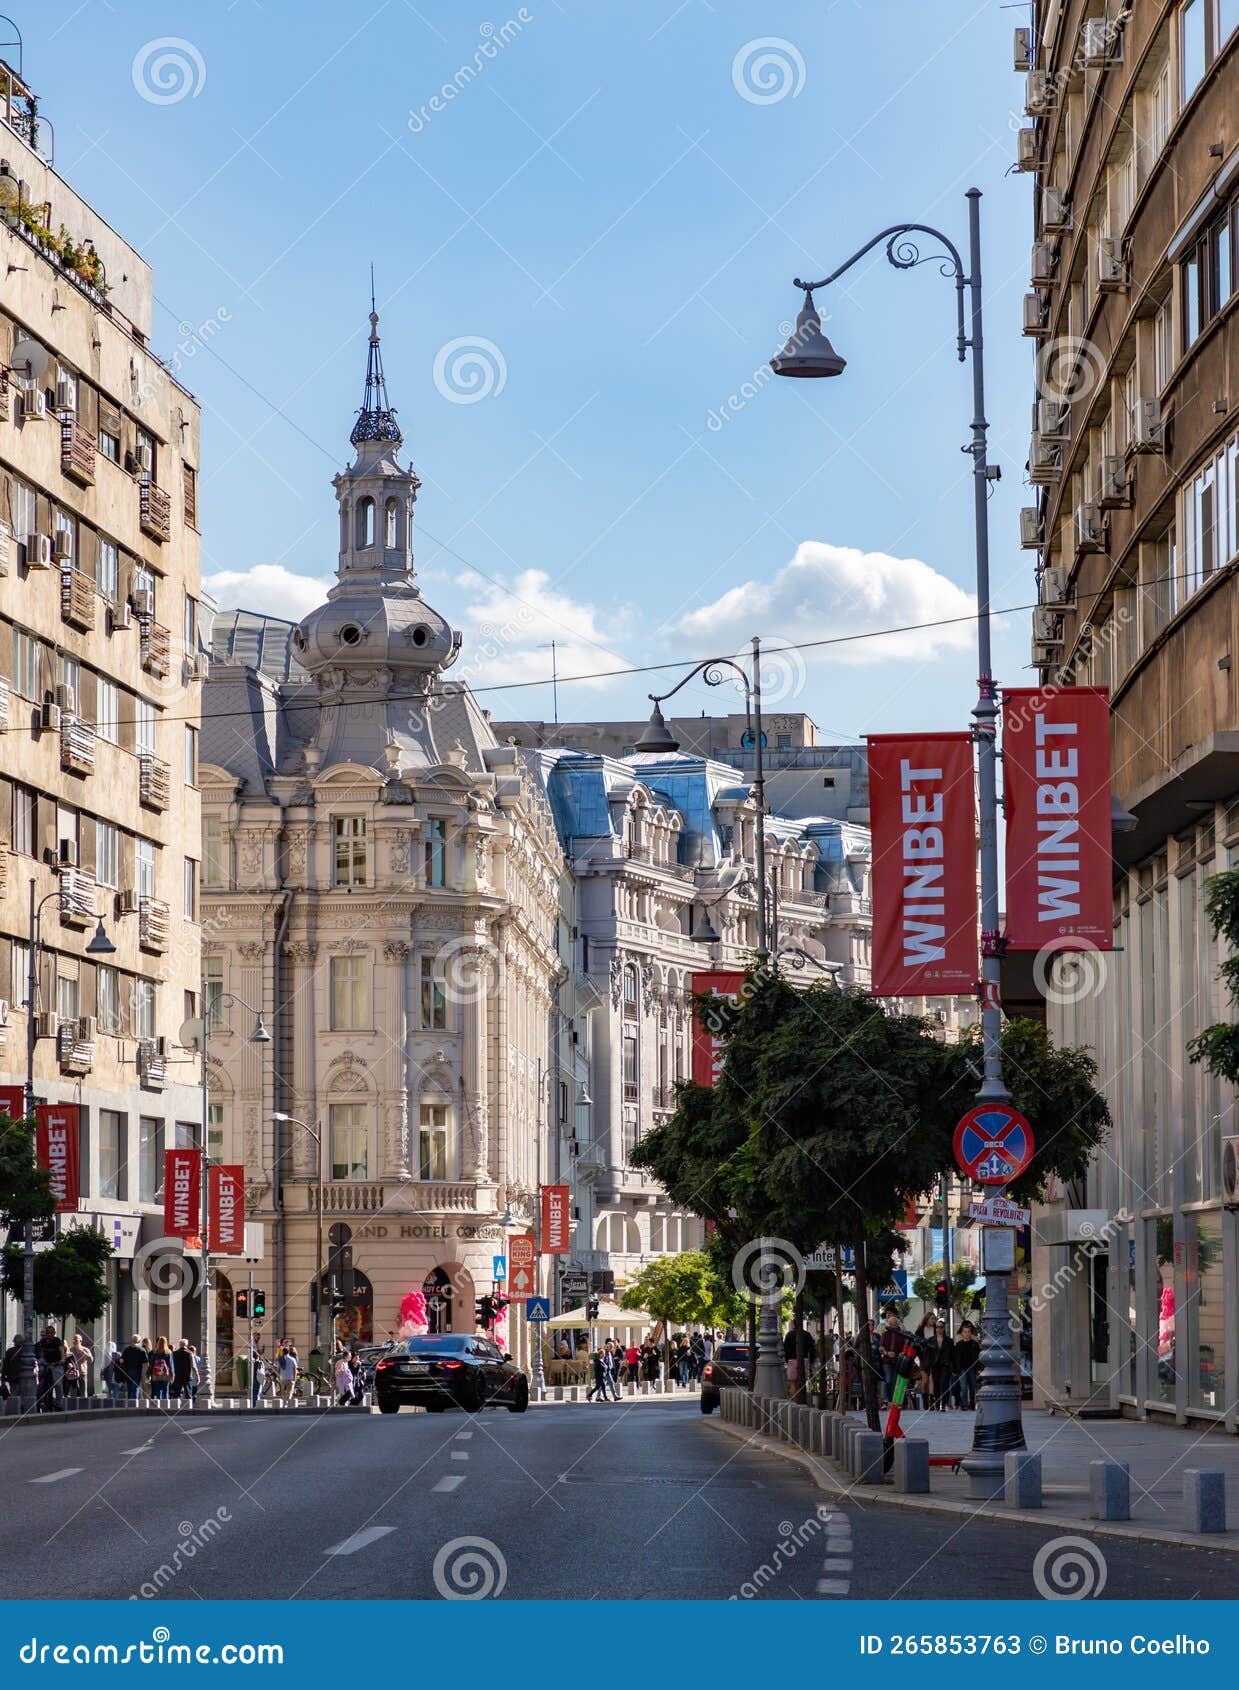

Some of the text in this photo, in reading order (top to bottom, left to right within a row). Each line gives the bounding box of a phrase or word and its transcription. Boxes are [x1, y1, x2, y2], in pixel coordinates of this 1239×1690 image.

[1035, 714, 1080, 922] WINBET
[900, 759, 946, 967] WINBET
[48, 1115, 67, 1200] WINBET
[174, 1158, 190, 1228] WINBET
[219, 1173, 234, 1244] WINBET
[355, 1225, 389, 1238] AND
[400, 1225, 449, 1238] HOTEL
[549, 1192, 562, 1247] WINBET
